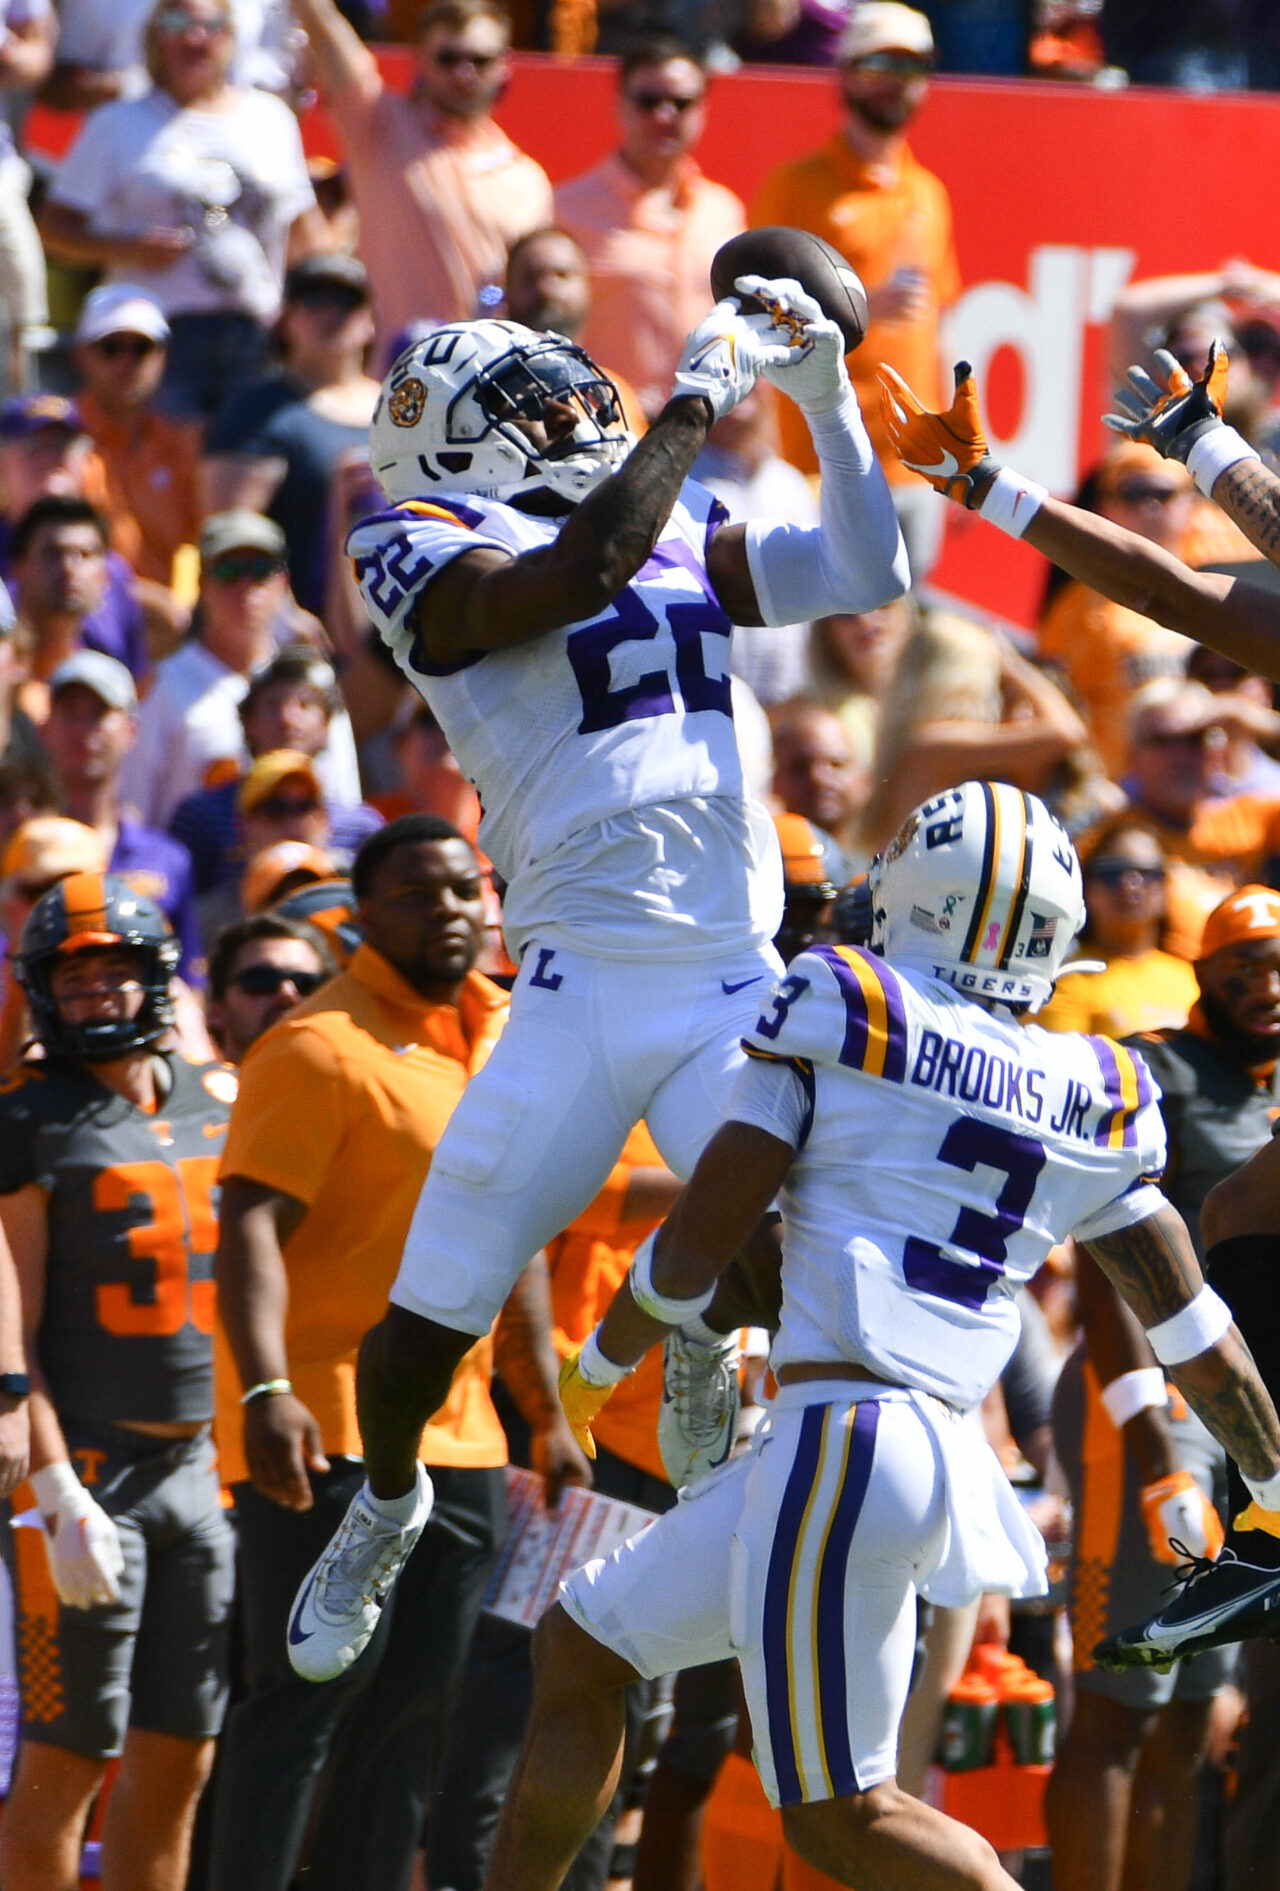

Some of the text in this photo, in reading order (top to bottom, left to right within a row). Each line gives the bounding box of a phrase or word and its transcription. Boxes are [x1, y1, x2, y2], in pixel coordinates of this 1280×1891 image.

[355, 532, 434, 620] 22
[566, 537, 734, 735] 22
[529, 948, 564, 991] L
[932, 964, 1033, 997] TIGERS
[1014, 942, 1026, 958] 3
[755, 974, 811, 1040] 3
[911, 1031, 1094, 1141] BROOKS JR.
[902, 1115, 1047, 1311] 3
